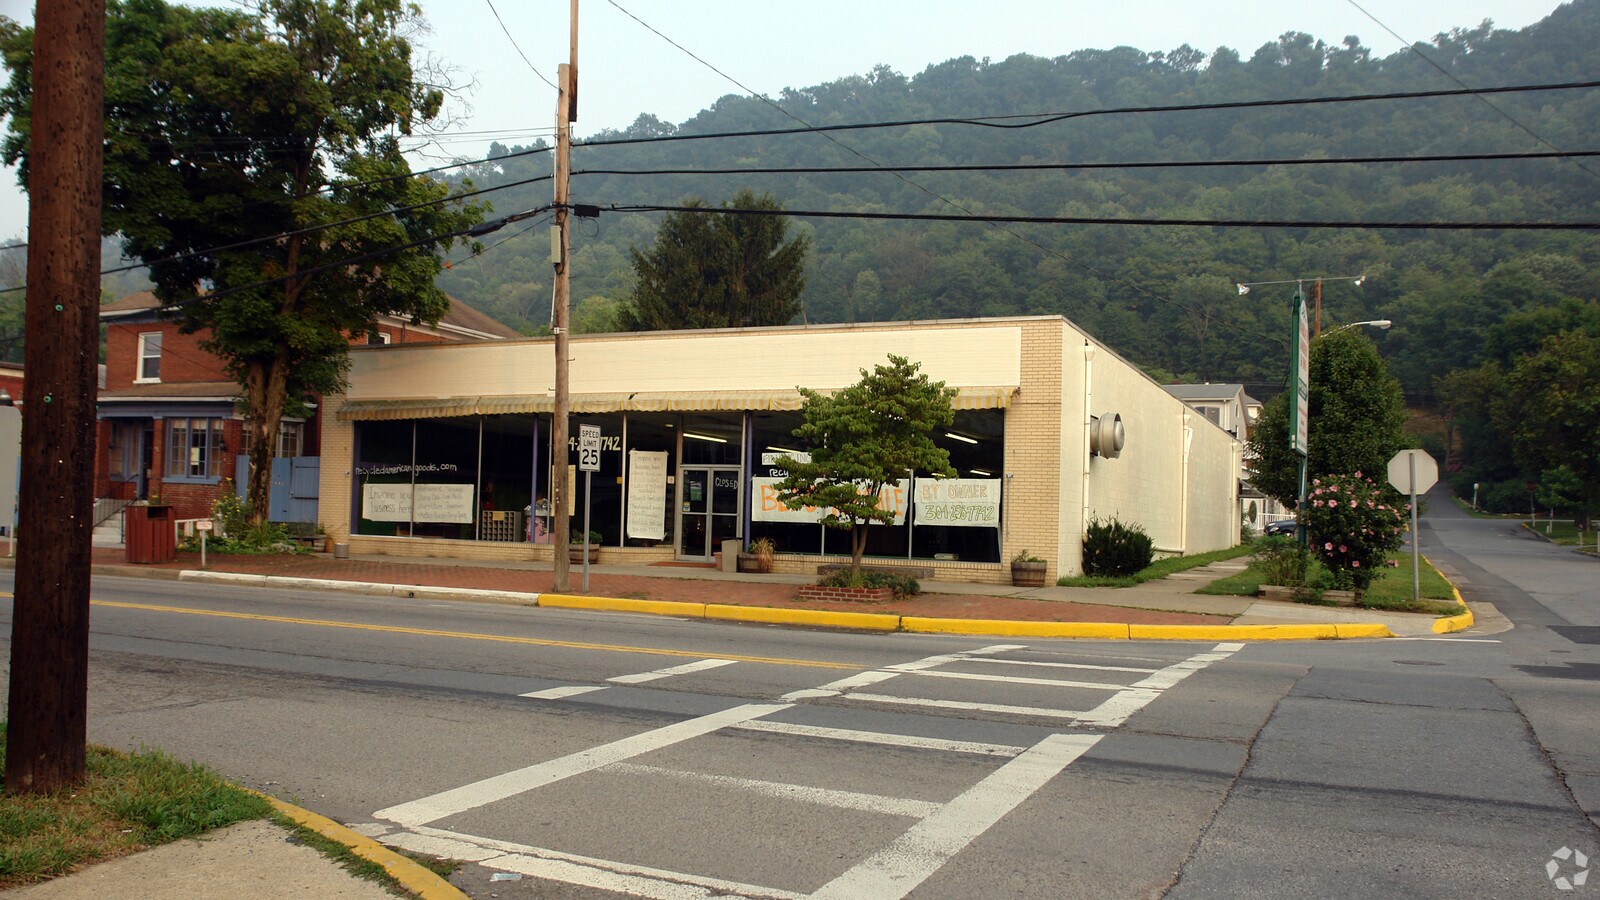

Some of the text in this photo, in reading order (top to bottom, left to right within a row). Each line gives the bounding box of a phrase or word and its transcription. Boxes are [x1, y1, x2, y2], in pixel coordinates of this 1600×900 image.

[582, 430, 599, 438] SPEED
[582, 449, 598, 465] 25
[922, 483, 987, 499] BY OWNER
